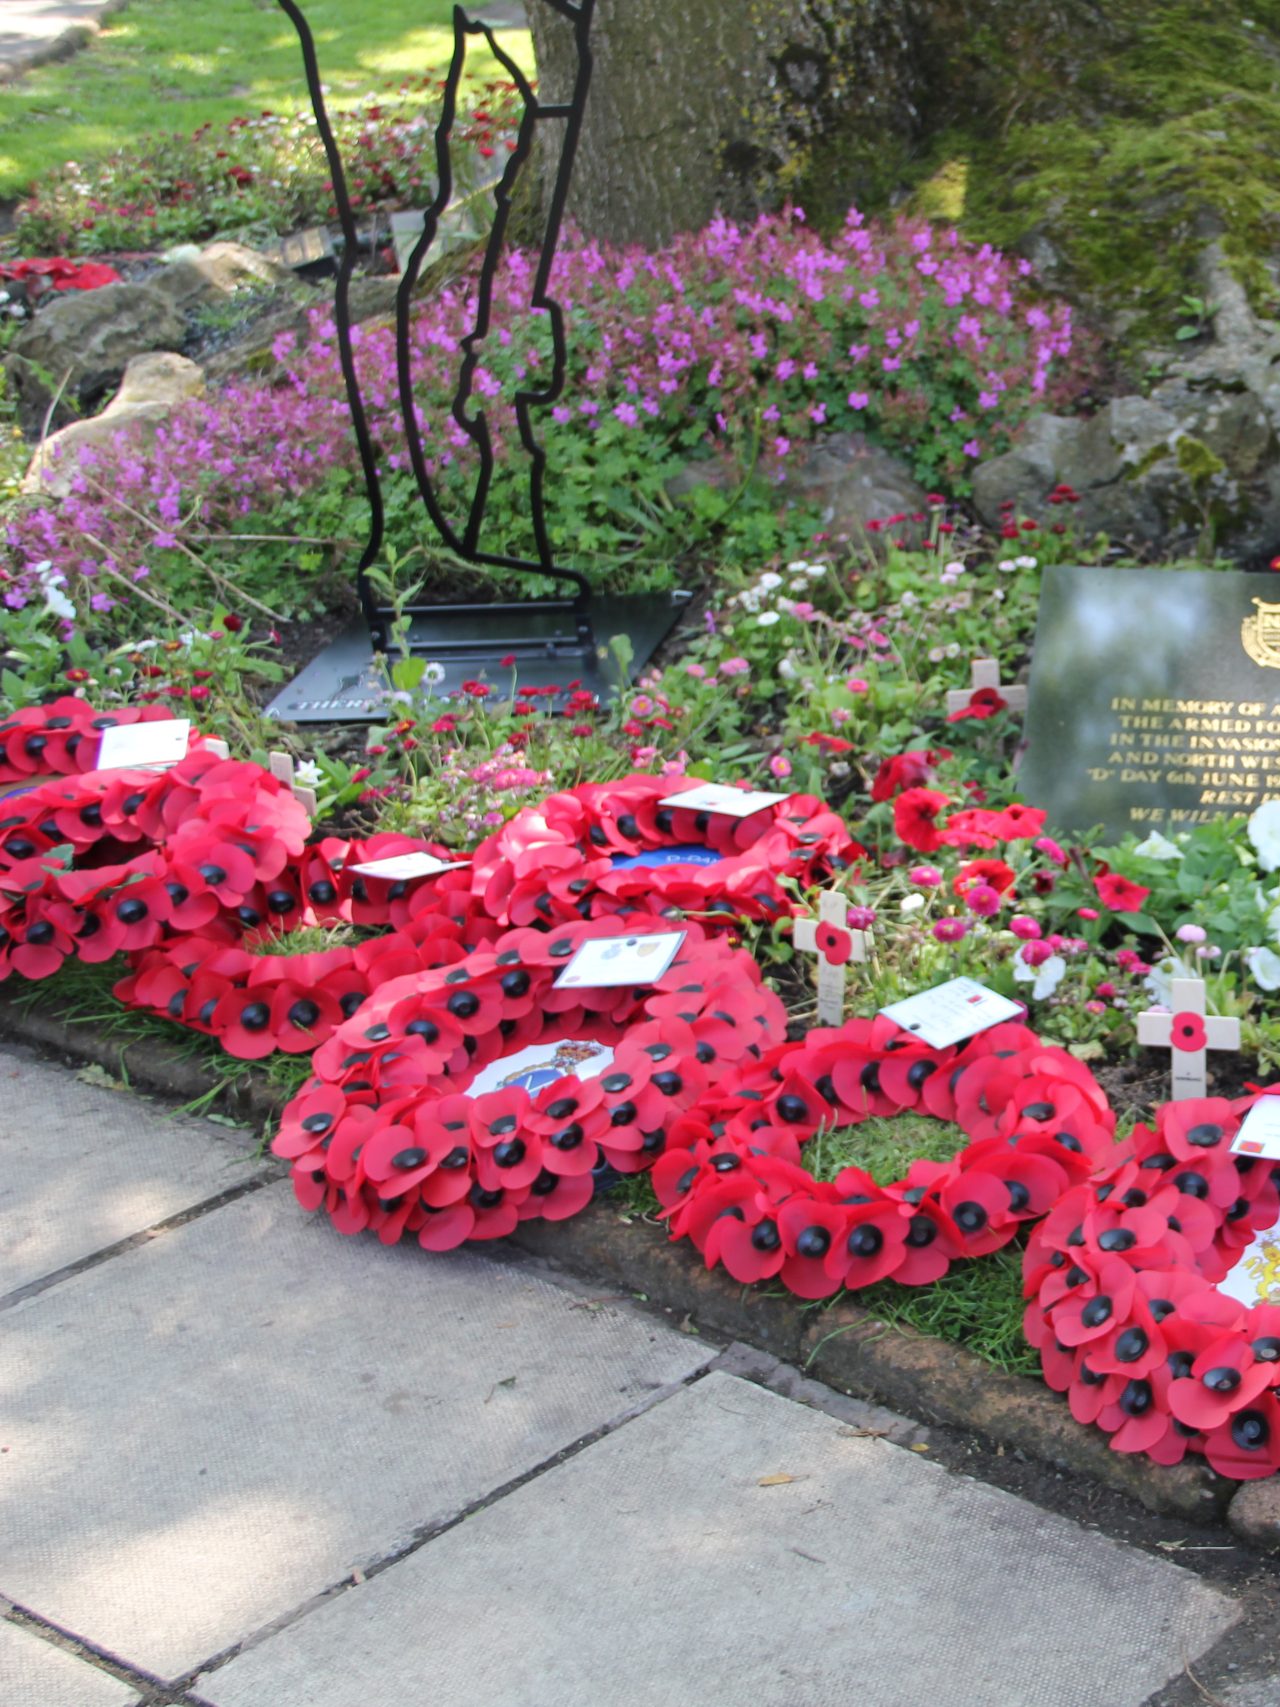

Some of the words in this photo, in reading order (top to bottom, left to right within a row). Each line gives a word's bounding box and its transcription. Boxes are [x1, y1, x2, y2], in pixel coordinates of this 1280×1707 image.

[1111, 698, 1136, 710] IN
[1142, 699, 1234, 715] MEMORY
[1238, 702, 1266, 716] OF
[1119, 715, 1163, 728] THE
[1168, 718, 1251, 733] ARMED
[1110, 733, 1135, 746] IN
[1140, 734, 1184, 747] THE
[1107, 751, 1159, 764] AND
[1163, 752, 1235, 768] NORTH
[1120, 768, 1162, 782] DAY
[1166, 771, 1196, 784] 6th
[1200, 773, 1260, 788] JUNE
[1200, 790, 1257, 806] REST
[1130, 807, 1166, 822] WE
